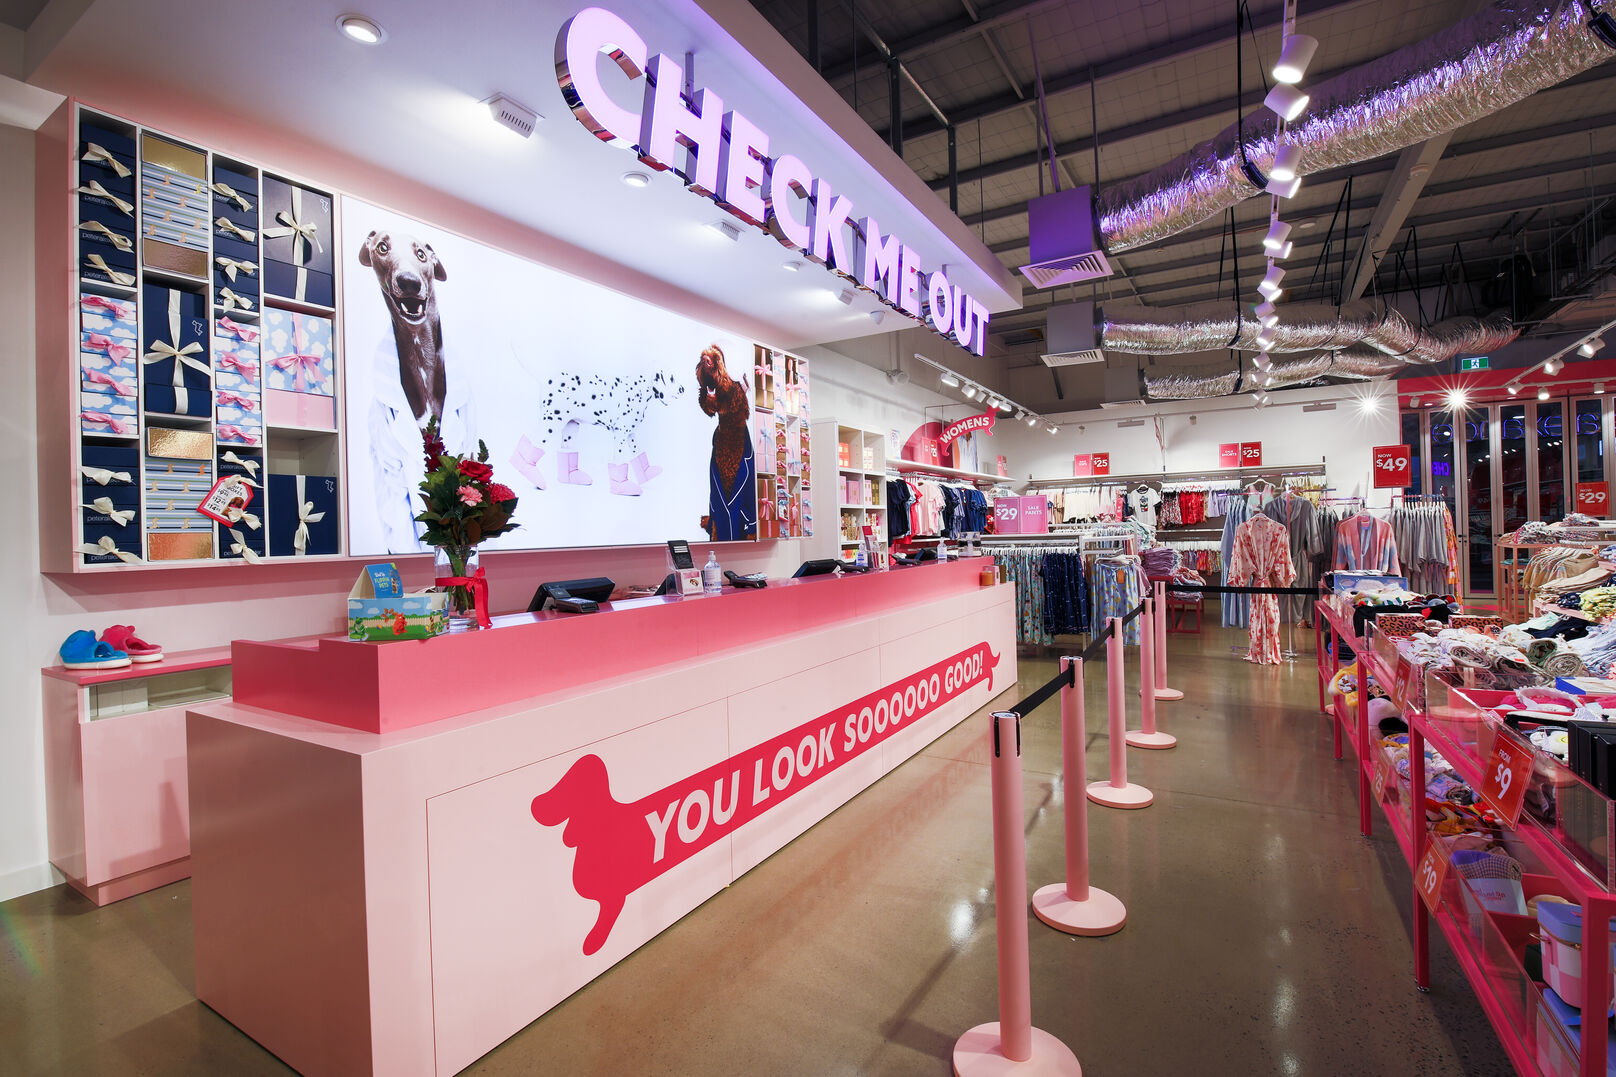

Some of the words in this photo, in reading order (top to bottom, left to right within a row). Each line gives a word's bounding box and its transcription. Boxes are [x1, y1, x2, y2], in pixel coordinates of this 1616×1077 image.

[556, 6, 853, 276] CHECK
[861, 216, 921, 318] ME
[927, 270, 990, 357] OUT
[940, 416, 990, 444] WOMENS
[1242, 449, 1260, 458] $25
[1094, 459, 1108, 468] $25
[1376, 457, 1407, 472] $49
[1579, 491, 1606, 504] $29
[996, 507, 1018, 521] $29
[644, 769, 740, 864] YOU
[752, 722, 837, 807] LOOK
[843, 673, 941, 752] SOOOOOO
[944, 650, 984, 694] GOOD!
[1499, 748, 1512, 764] FROM
[1494, 762, 1512, 800] $9
[1423, 860, 1437, 895] $19
